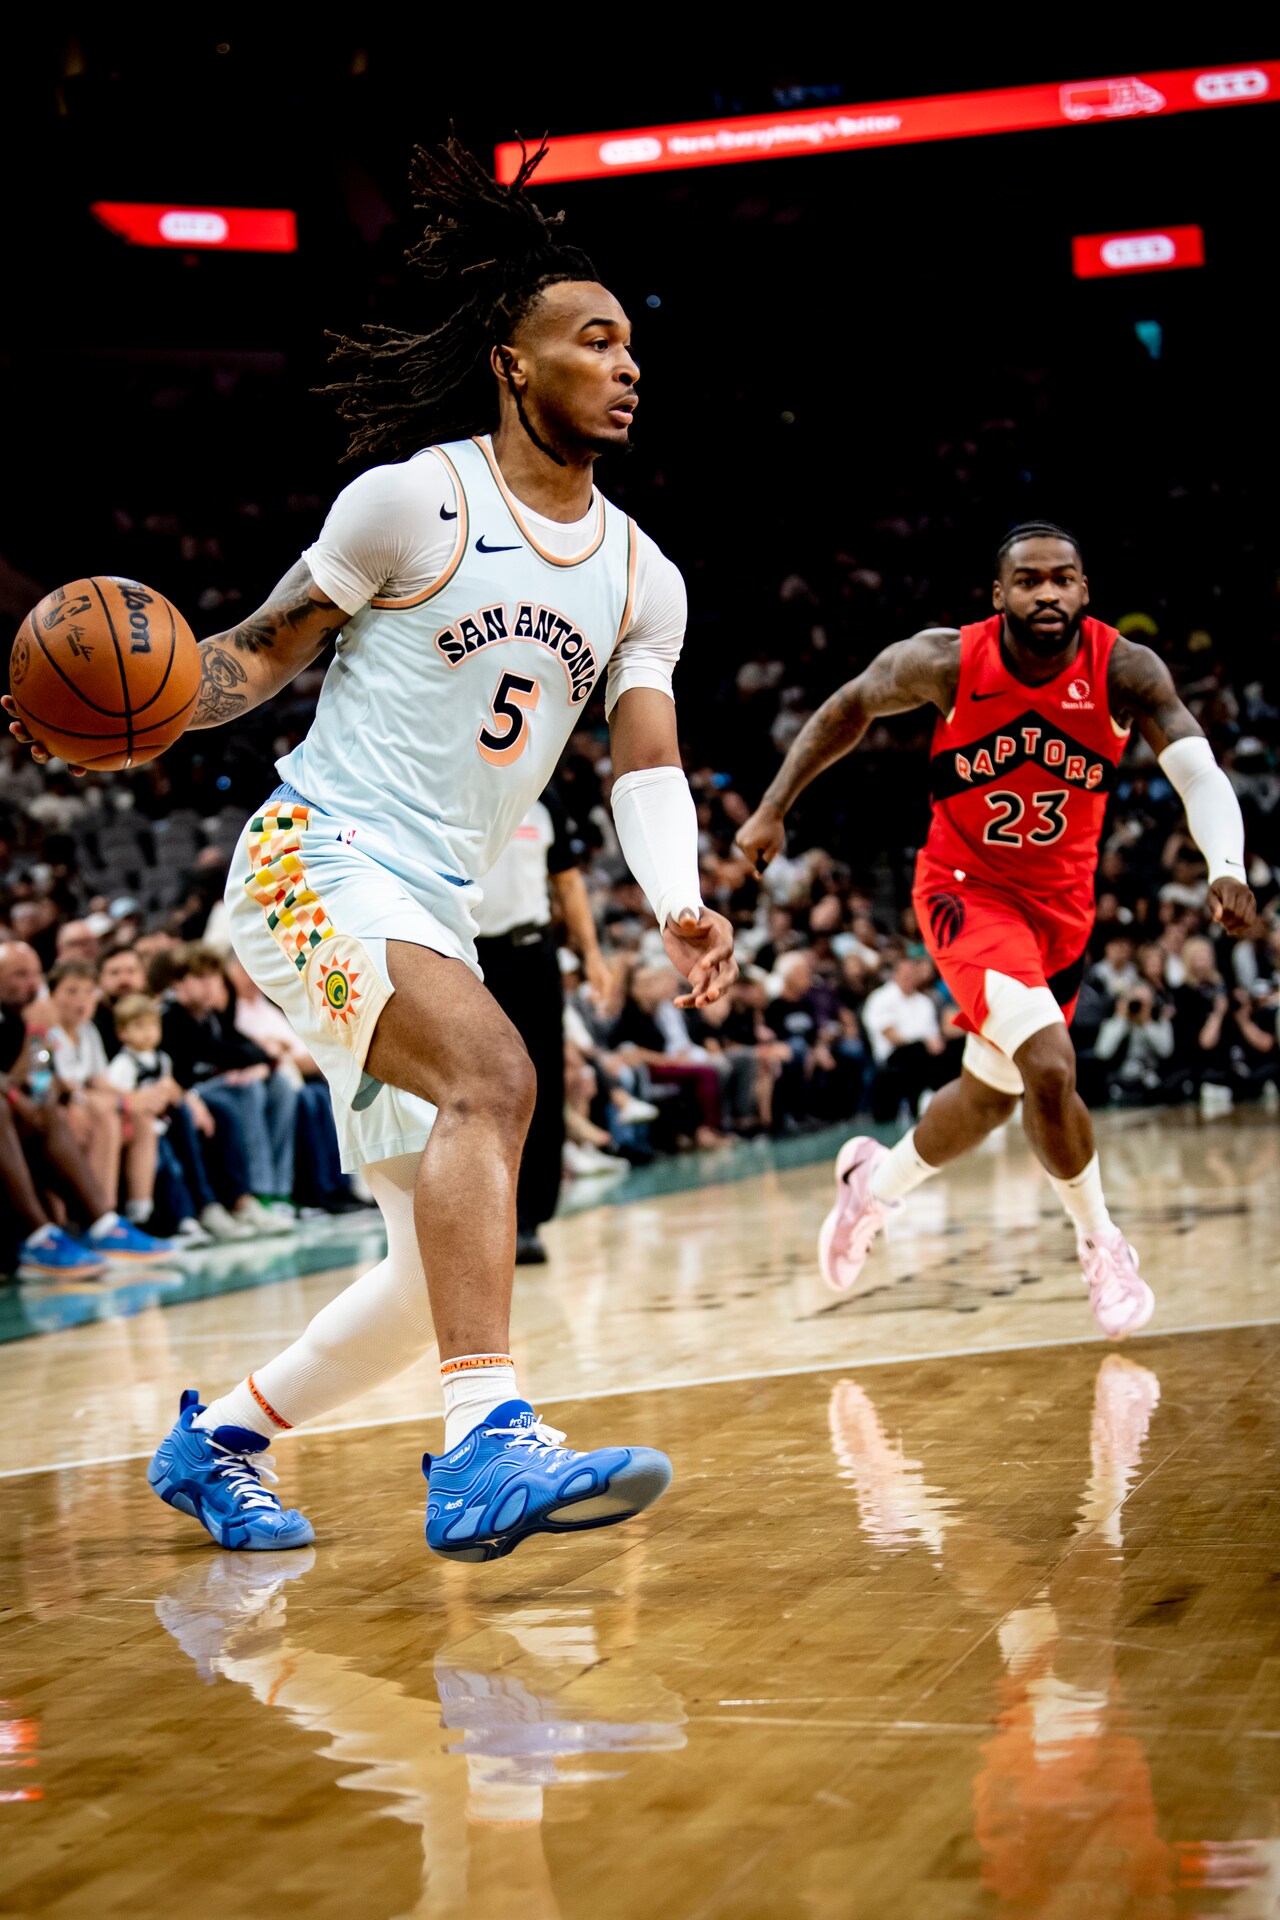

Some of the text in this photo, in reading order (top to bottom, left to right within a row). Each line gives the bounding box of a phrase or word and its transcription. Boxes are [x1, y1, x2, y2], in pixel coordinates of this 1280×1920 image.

[434, 602, 597, 706] SAN ANTONIO
[476, 669, 540, 766] 5
[955, 727, 1103, 789] RAPTORS
[983, 789, 1069, 848] 23
